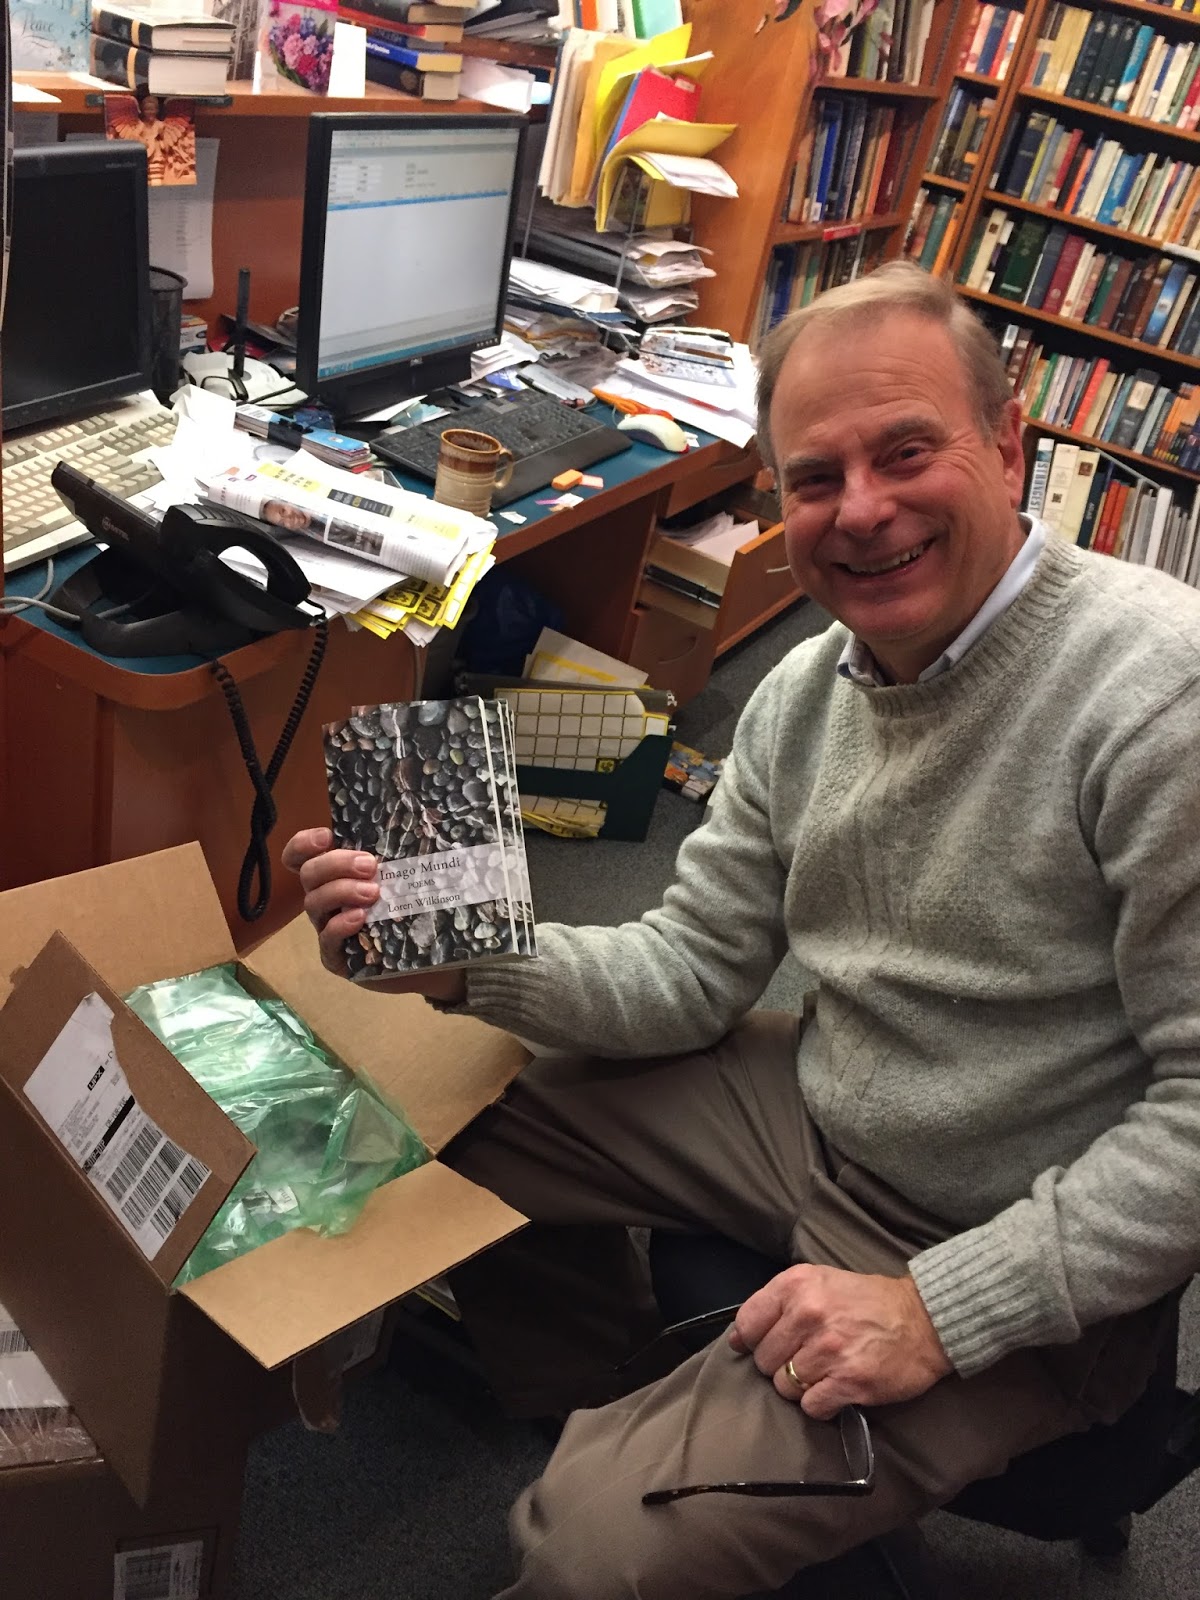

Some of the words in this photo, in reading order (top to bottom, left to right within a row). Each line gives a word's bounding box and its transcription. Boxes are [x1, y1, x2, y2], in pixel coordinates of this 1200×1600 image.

[380, 867, 416, 881] Imago
[421, 857, 461, 873] Mundi
[408, 879, 436, 889] POEMS
[388, 903, 414, 913] Loren
[415, 894, 461, 907] Wilkinson
